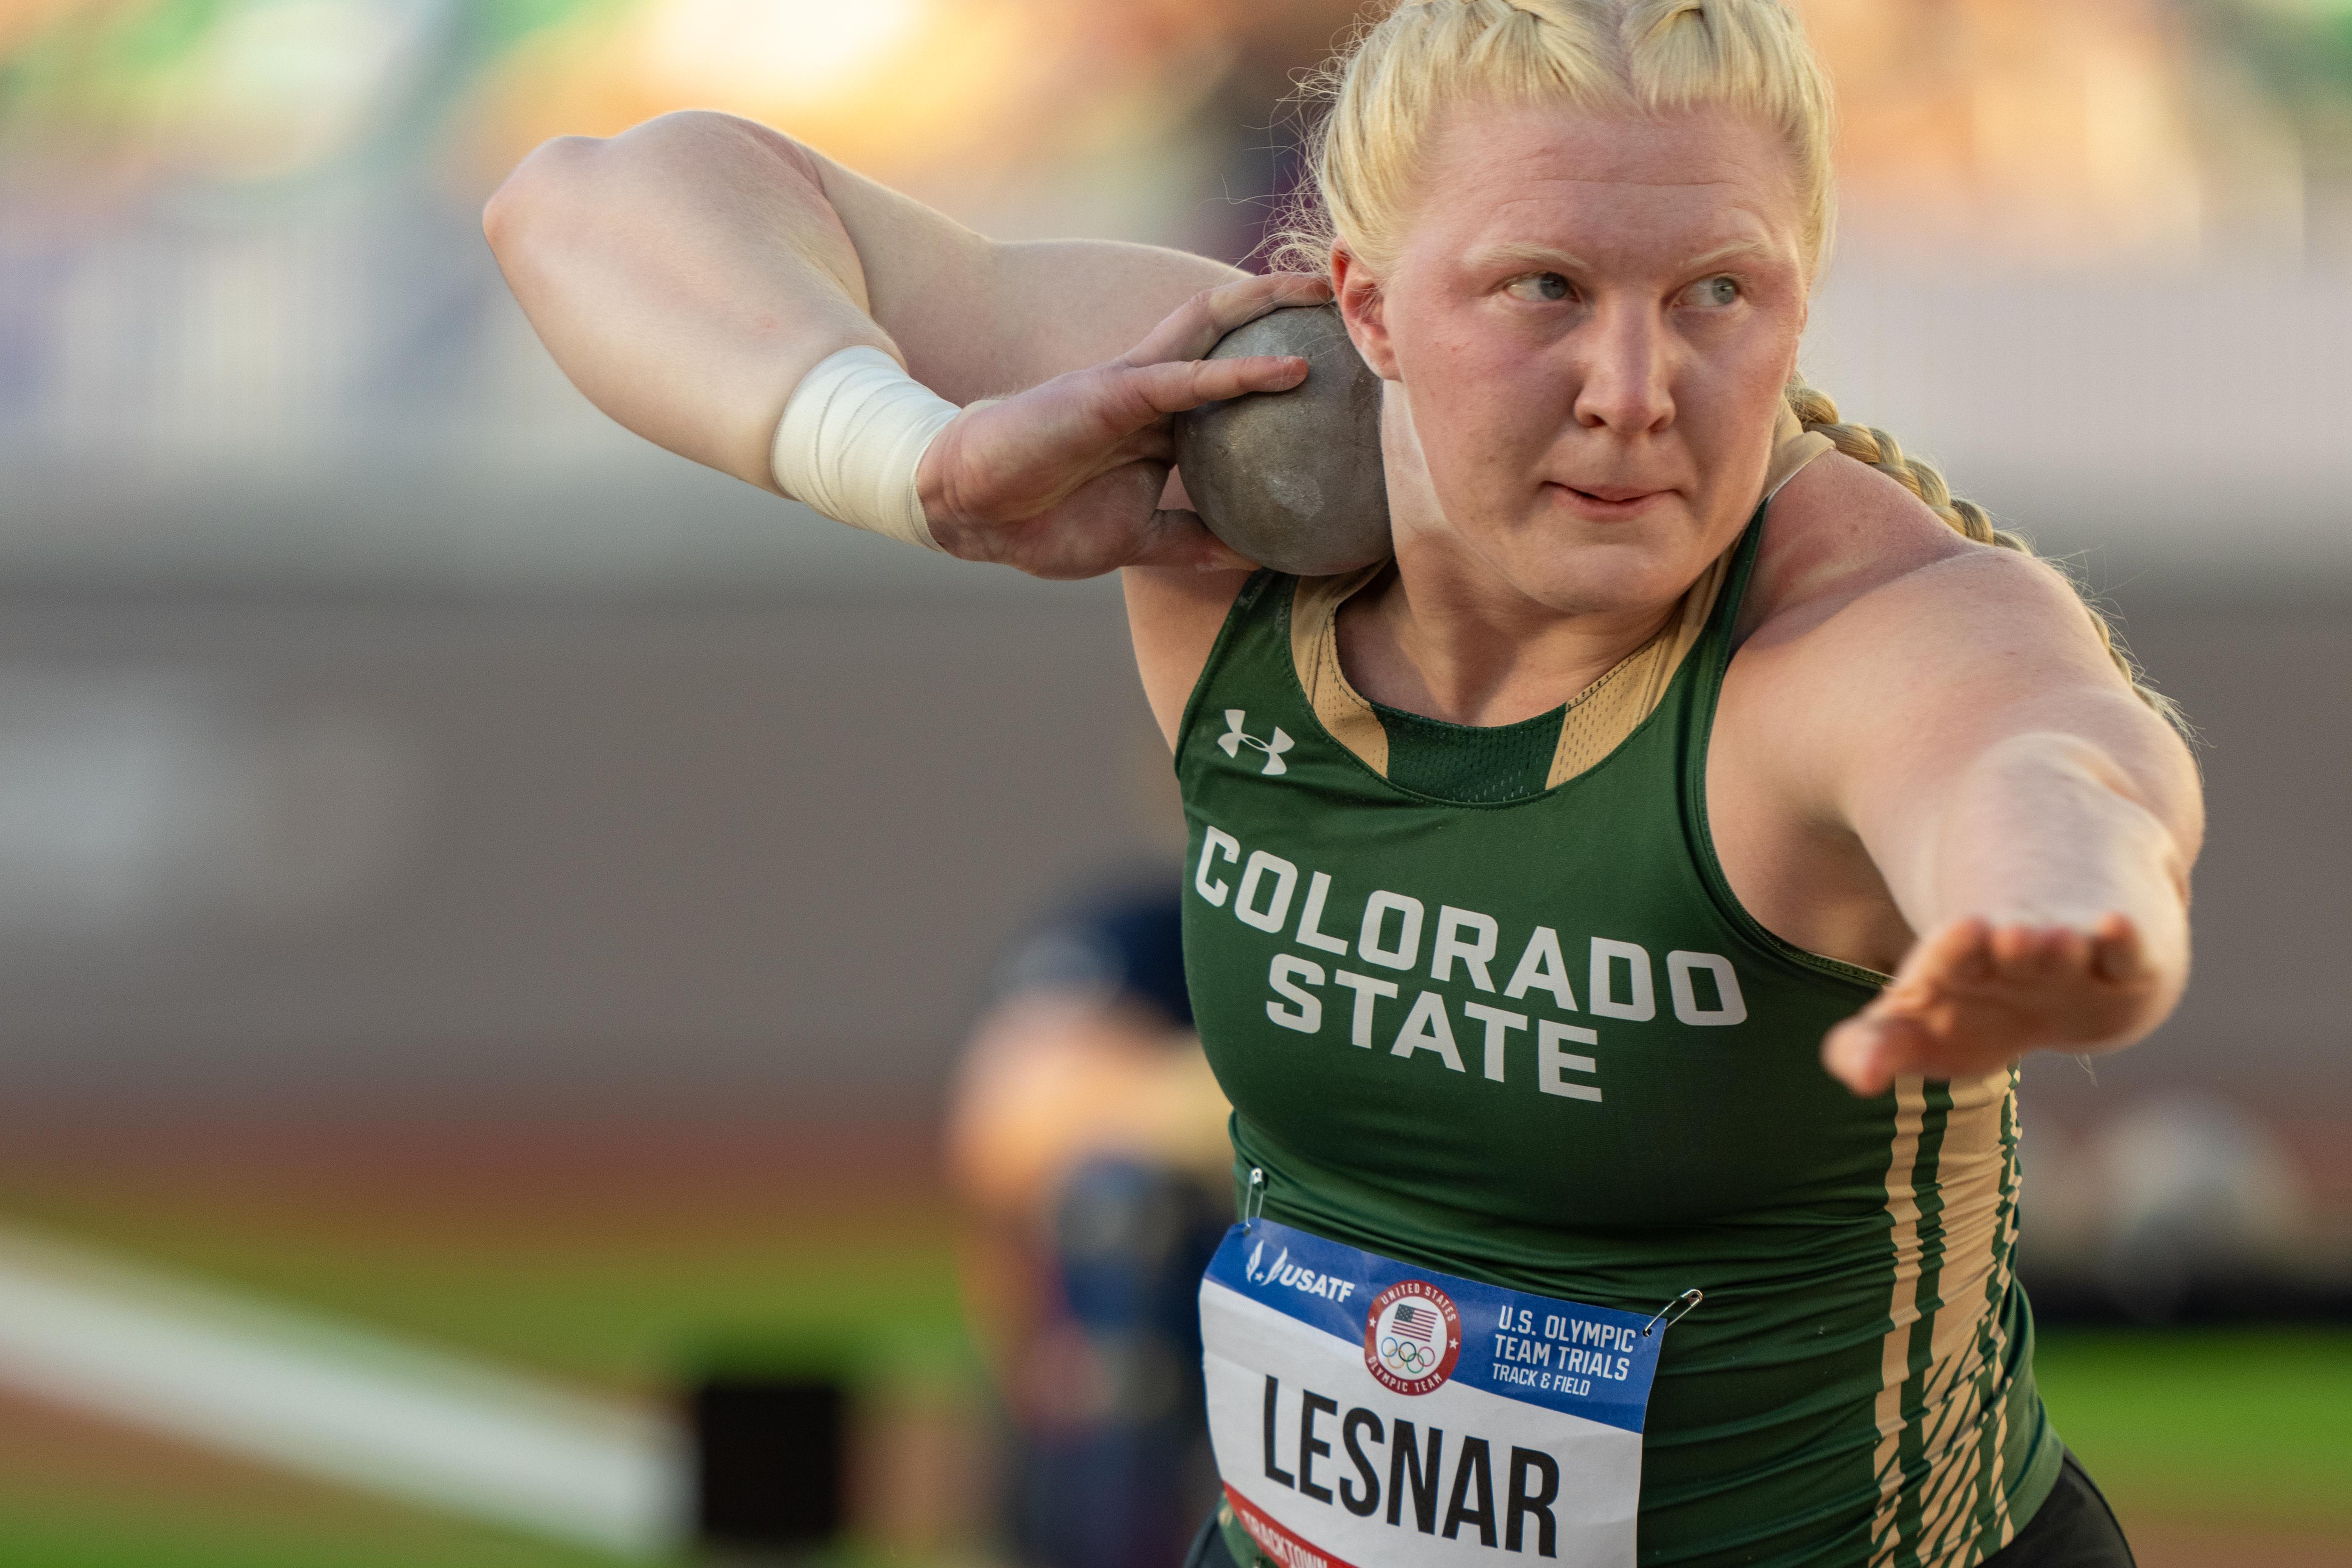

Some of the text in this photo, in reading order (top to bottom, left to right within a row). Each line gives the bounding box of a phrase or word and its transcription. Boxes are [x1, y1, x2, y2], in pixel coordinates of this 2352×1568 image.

[1195, 826, 1747, 1026] COLORADO
[1266, 953, 1603, 1103] STATE
[1279, 1264, 1355, 1303] USATF
[1381, 1283, 1457, 1321] UNITED STATES
[1499, 1305, 1636, 1353] U.S. OLYMPIC
[1368, 1356, 1443, 1393] OLYMPIC TEAM
[1493, 1362, 1591, 1396] TRACK & FIELD
[1495, 1334, 1630, 1381] TEAM TRIALS
[1263, 1374, 1559, 1558] LESNAR
